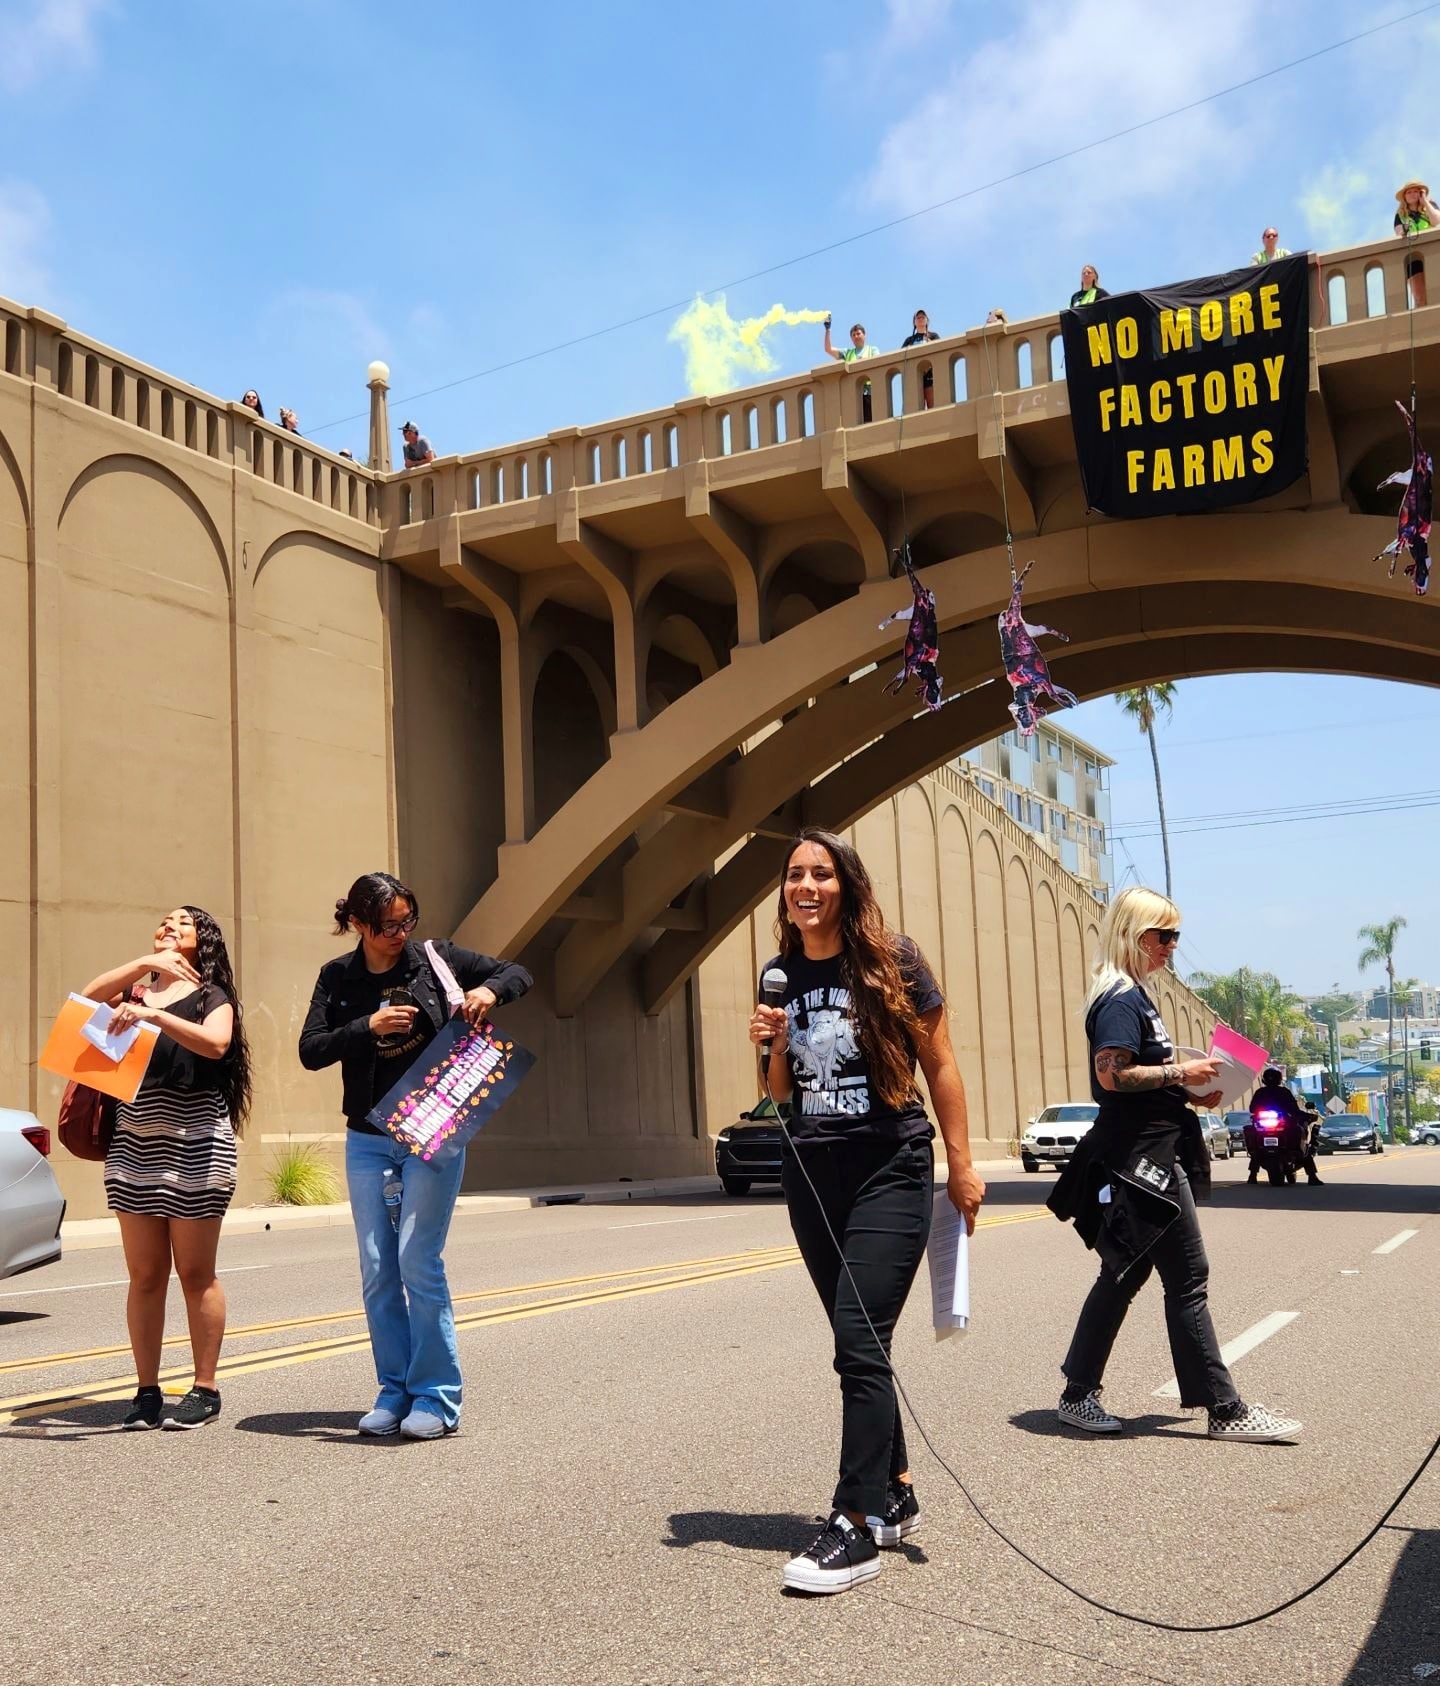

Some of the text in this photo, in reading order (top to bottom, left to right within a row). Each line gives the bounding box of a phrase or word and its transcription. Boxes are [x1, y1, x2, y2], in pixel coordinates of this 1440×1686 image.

[1086, 284, 1282, 368] NO MORE
[1099, 355, 1285, 432] FACTORY
[1126, 430, 1274, 494] FARMS
[802, 988, 824, 1010] THE
[399, 1035, 488, 1133] NO MORE OPPRESSION
[411, 1044, 503, 1145] ANIMAL LIBERATION
